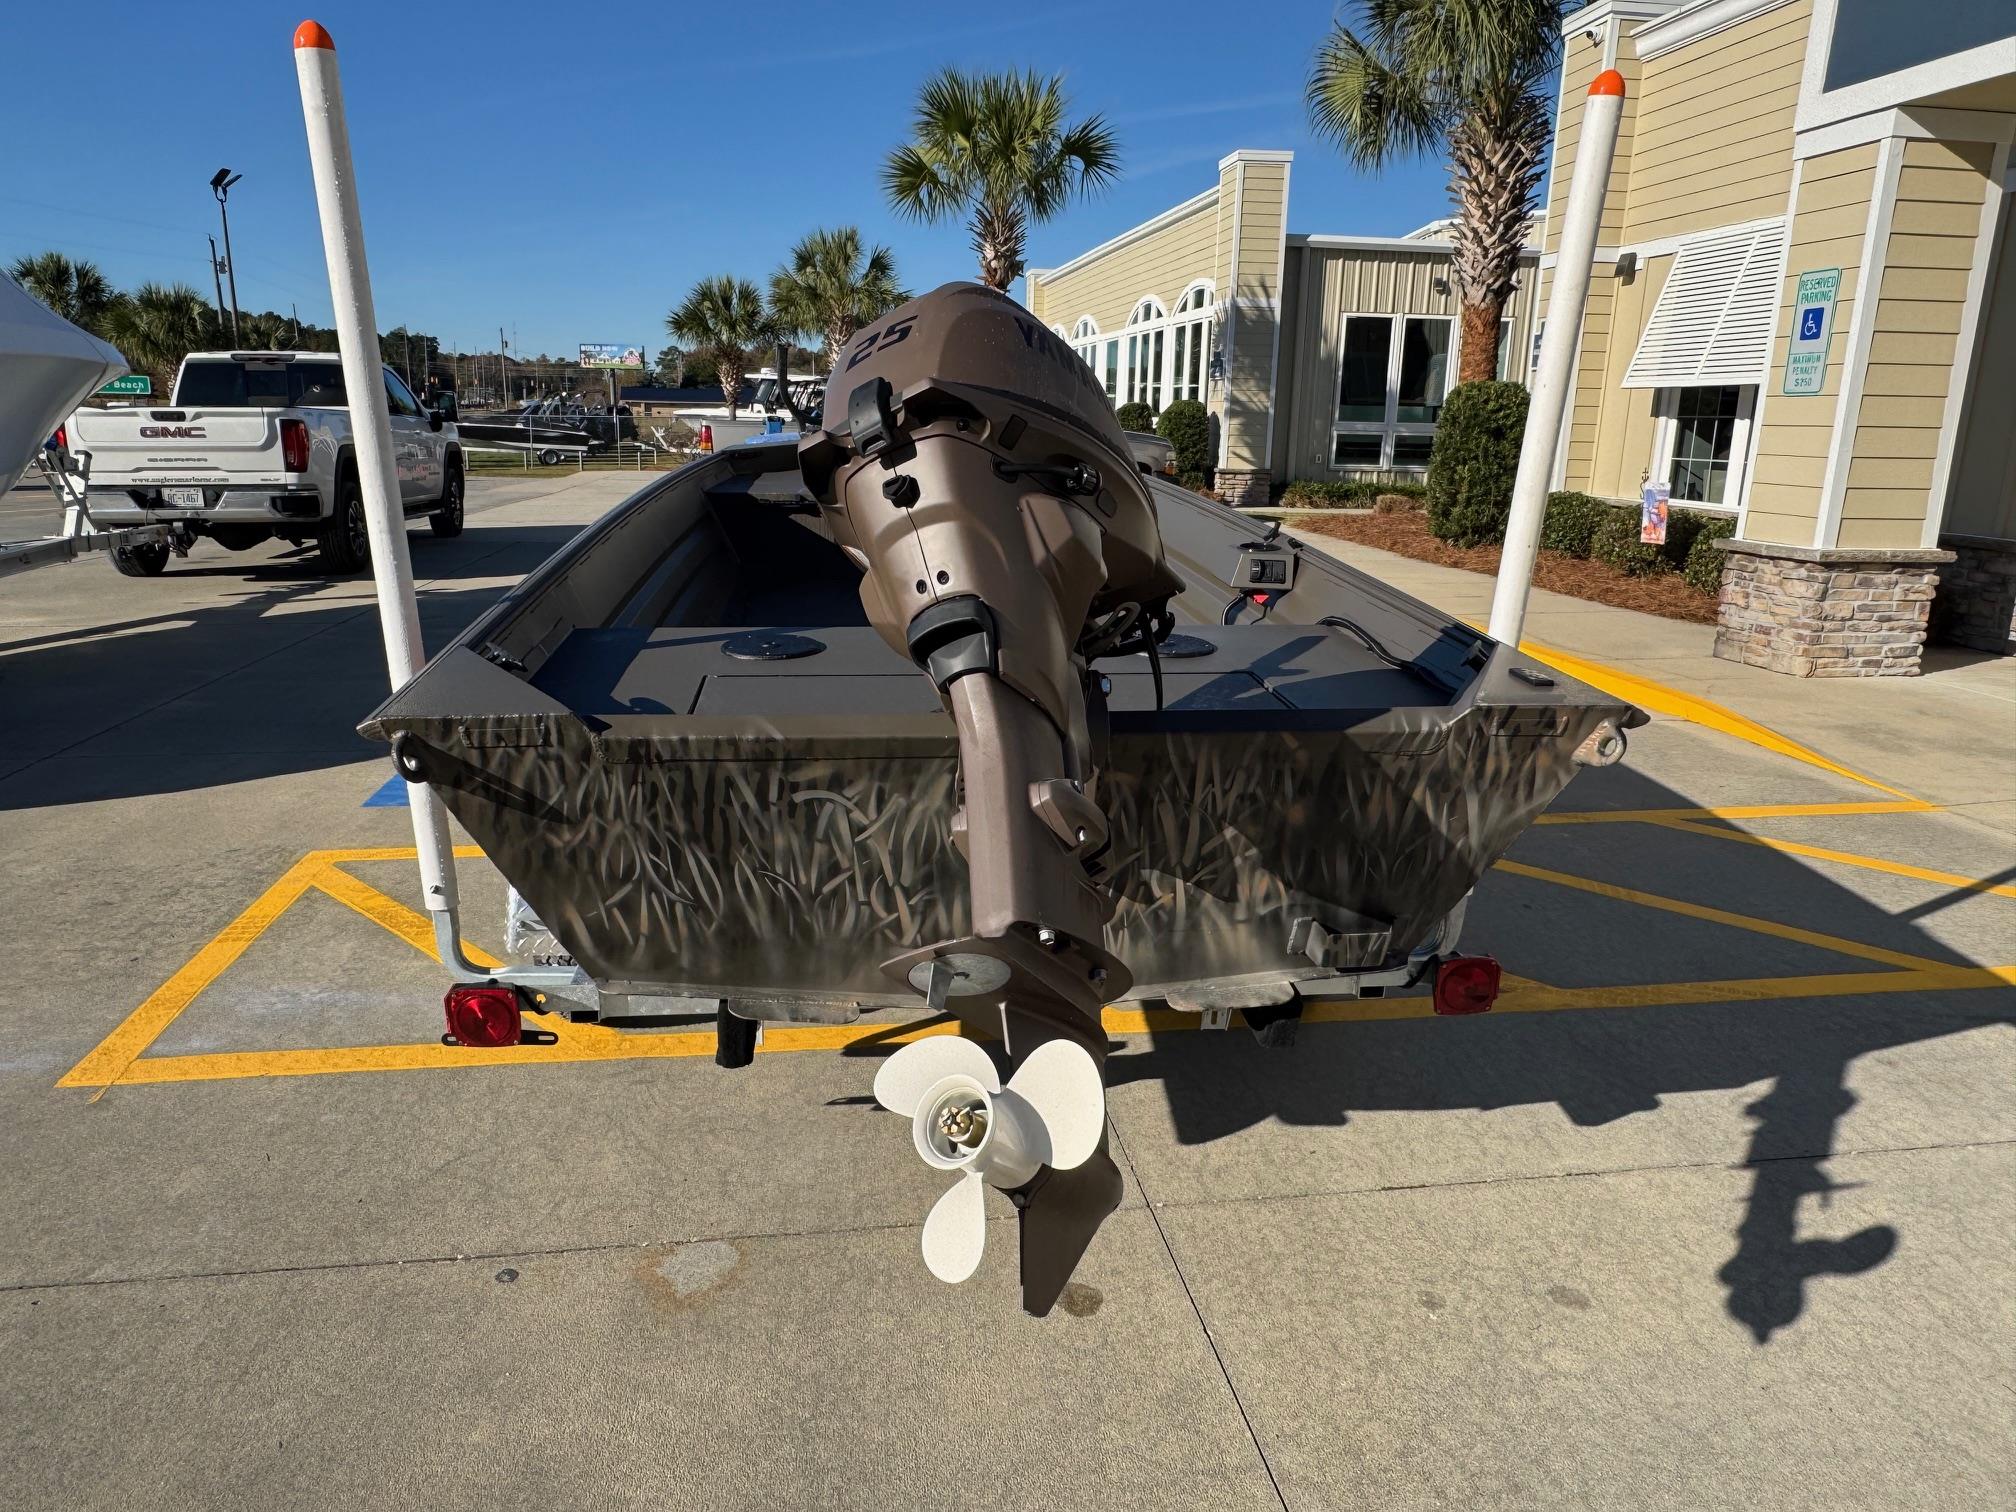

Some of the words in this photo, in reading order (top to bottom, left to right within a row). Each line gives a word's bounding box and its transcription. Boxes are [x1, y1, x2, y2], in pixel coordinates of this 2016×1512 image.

[1800, 276, 1836, 291] RESERVED
[1801, 291, 1832, 304] PARKING
[845, 314, 919, 374] 25
[1792, 354, 1821, 364] MAXIMUM
[1792, 365, 1818, 376] PENALTY
[113, 381, 144, 389] Beach
[139, 426, 207, 438] GMC
